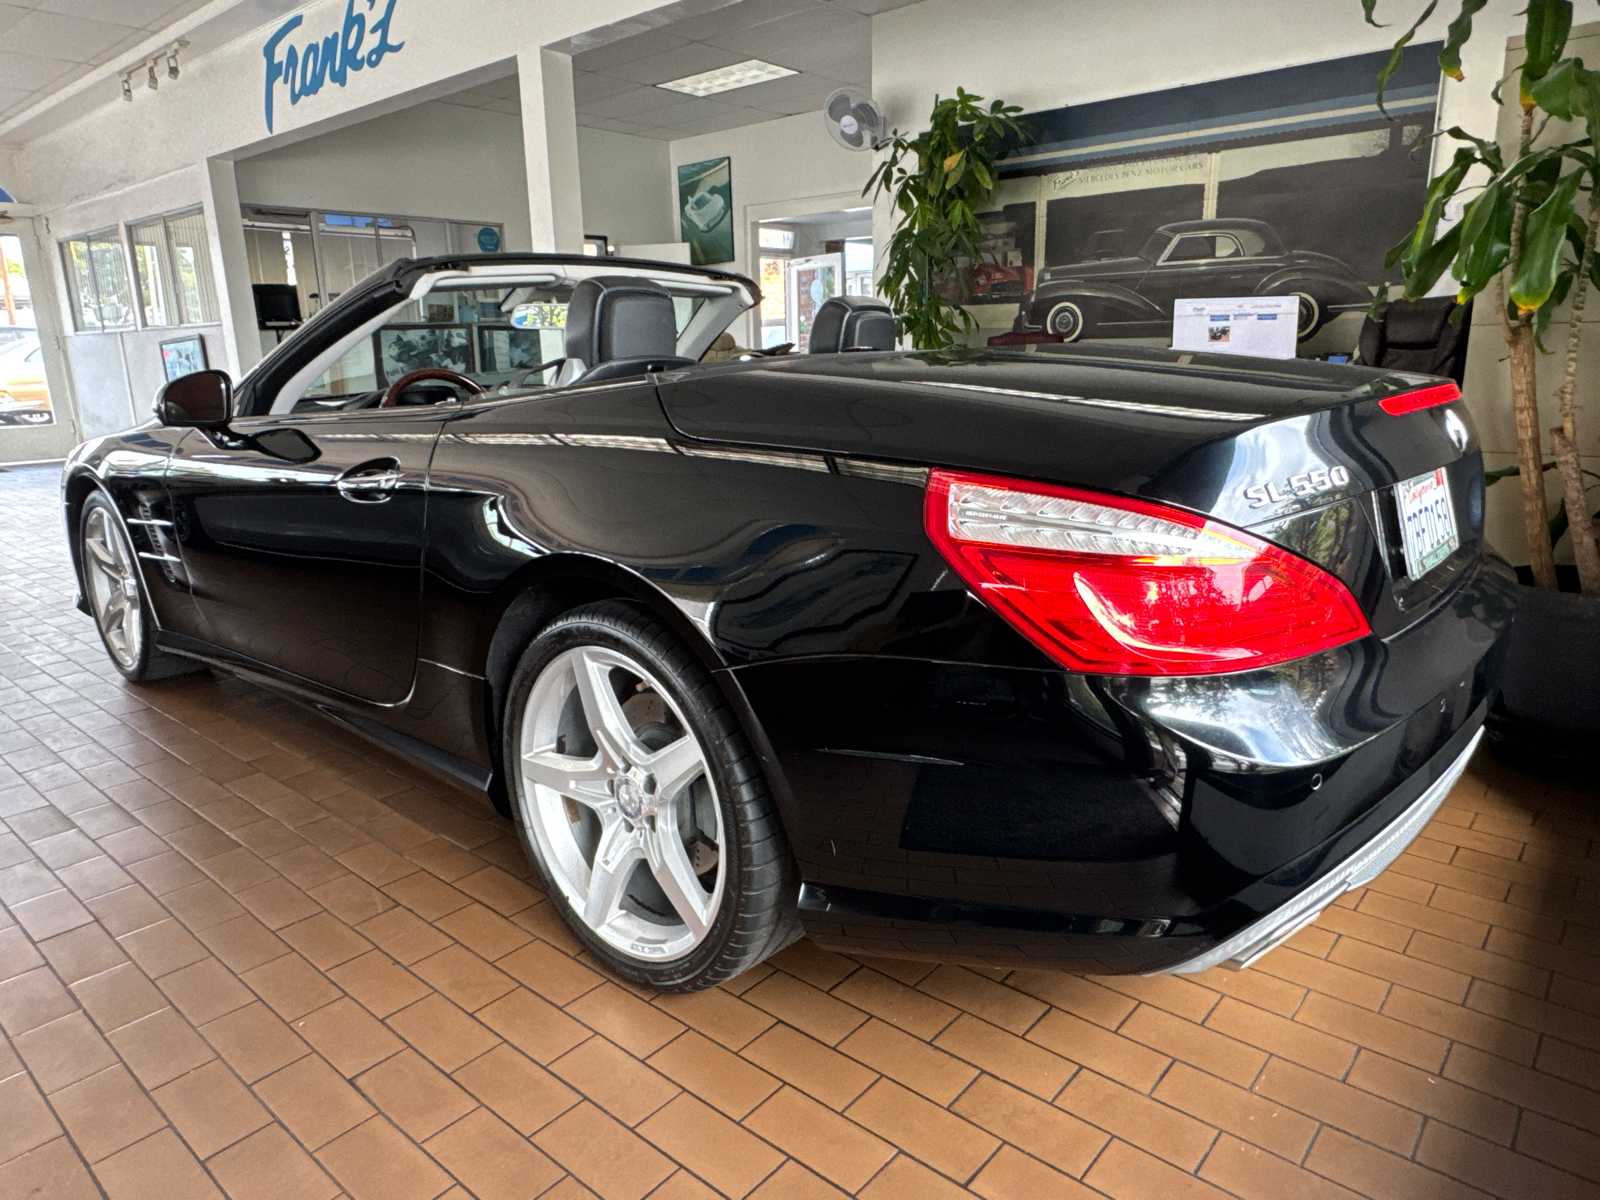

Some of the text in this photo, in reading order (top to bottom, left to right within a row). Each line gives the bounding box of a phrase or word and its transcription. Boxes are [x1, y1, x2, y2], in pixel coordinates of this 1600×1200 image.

[1145, 165, 1178, 177] MOTOR
[1180, 161, 1203, 172] CARS
[1243, 465, 1349, 509] SL 550
